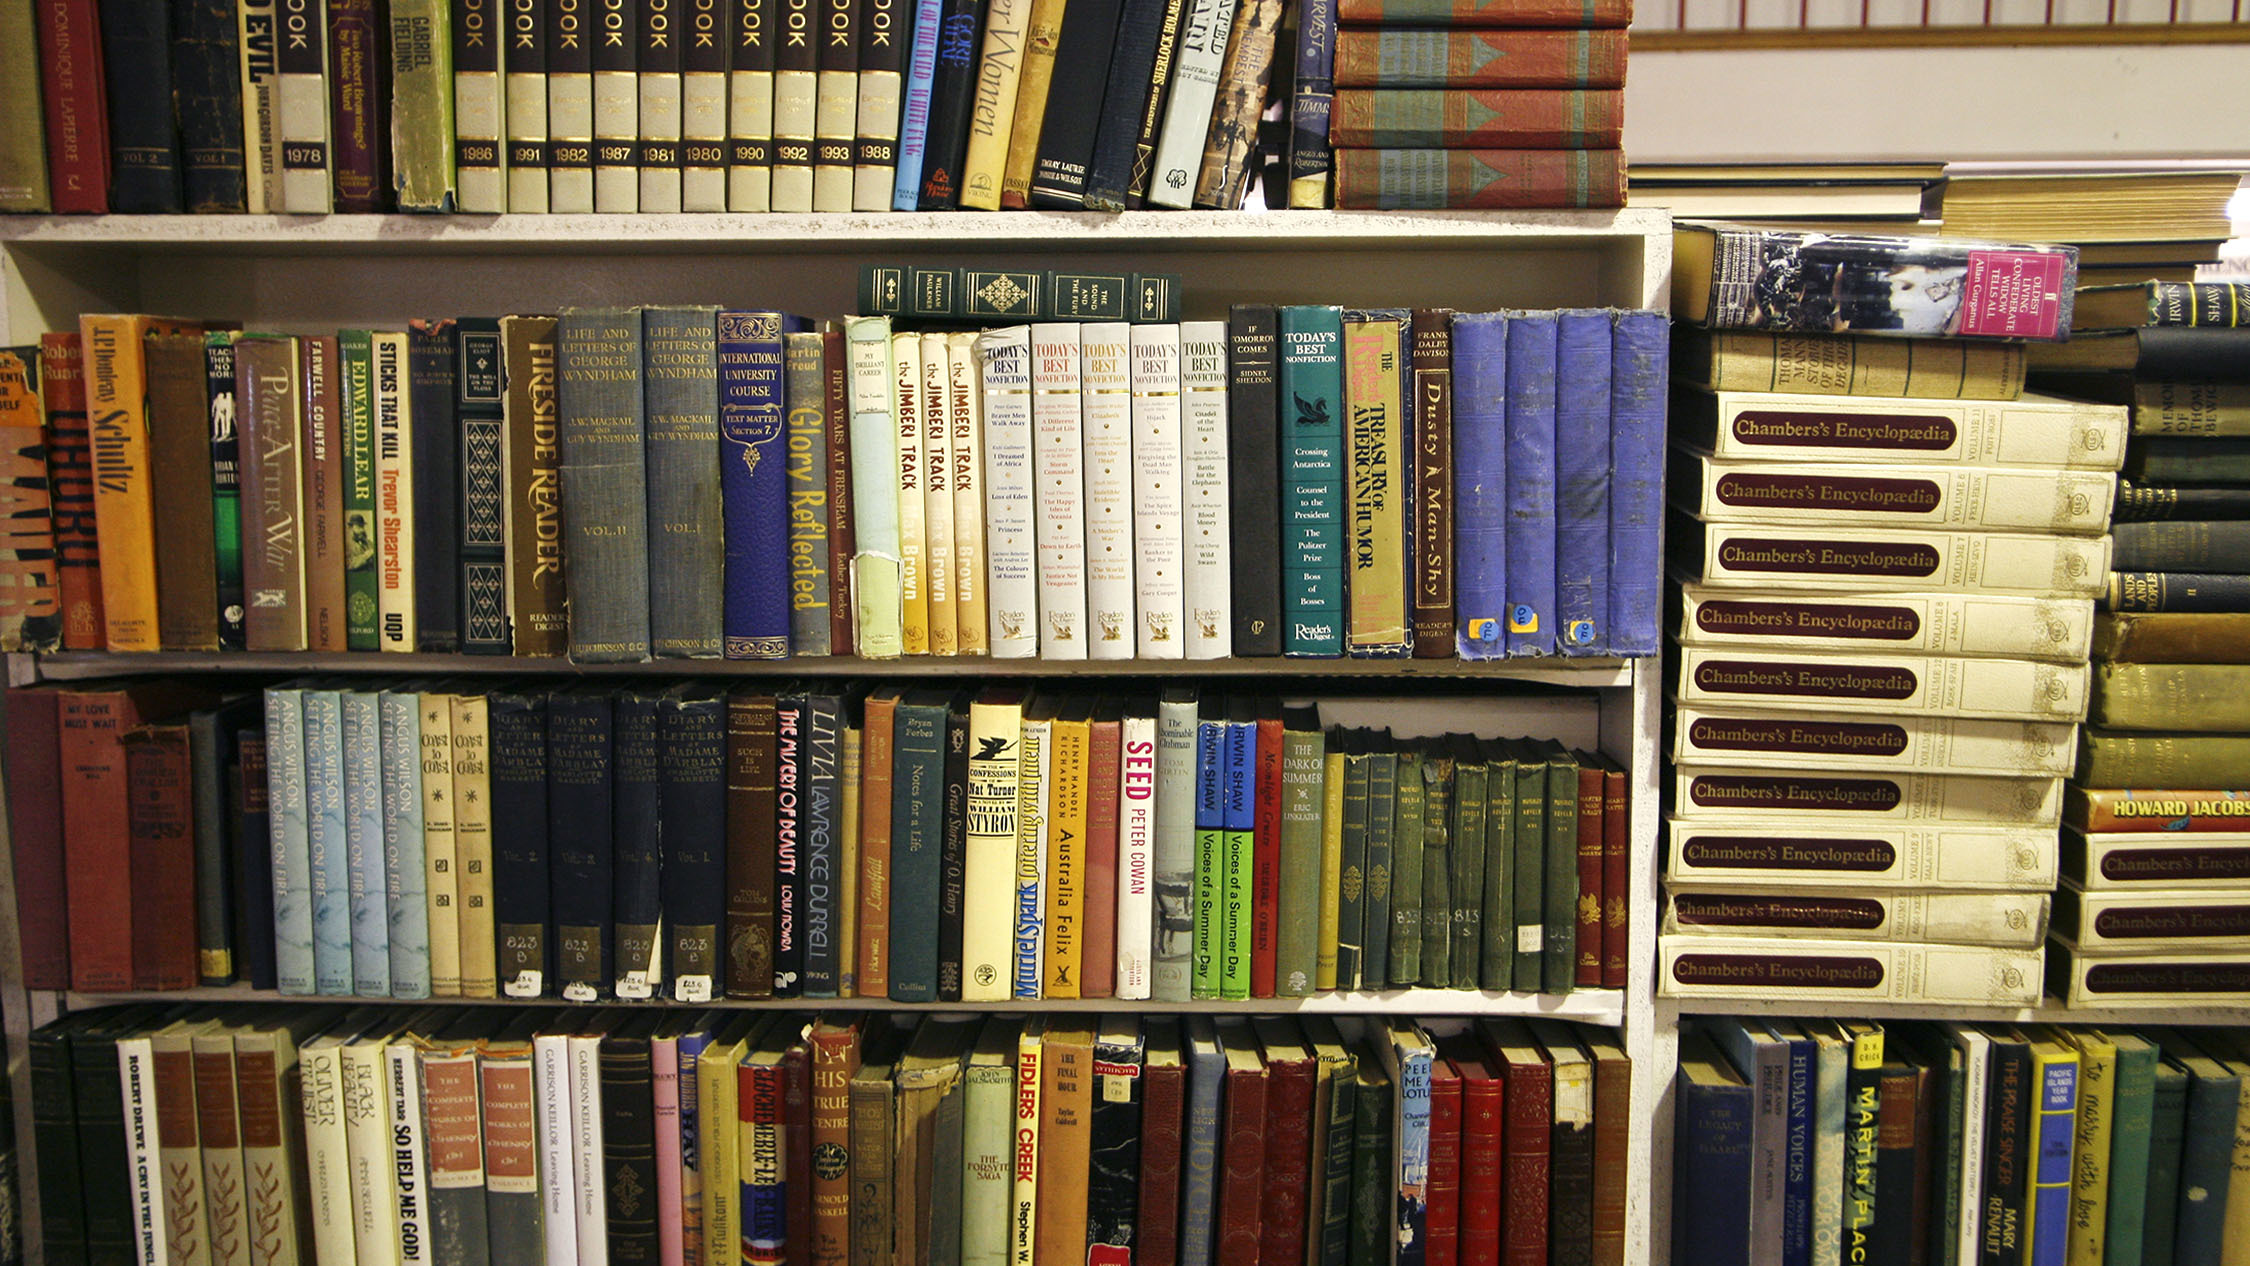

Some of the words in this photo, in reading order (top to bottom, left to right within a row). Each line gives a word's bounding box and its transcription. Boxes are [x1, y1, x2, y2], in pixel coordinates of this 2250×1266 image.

[54, 2, 73, 89] DOMINIQUE
[246, 14, 275, 83] EVIL
[394, 17, 413, 72] FIELDING
[412, 17, 430, 68] GABRIEL
[1153, 31, 1173, 86] SHERLOCK
[1235, 29, 1254, 85] TEMPEST
[1248, 47, 1264, 71] THE
[974, 29, 1019, 137] Women
[908, 89, 928, 126] WHITE
[60, 98, 79, 162] LAPIERRE
[905, 128, 925, 157] FANG
[288, 149, 321, 163] 1978
[462, 147, 493, 161] 1986
[515, 148, 541, 162] 1991
[555, 148, 588, 162] 1982
[600, 147, 631, 161] 1987
[643, 148, 675, 162] 1981
[686, 147, 721, 161] 1980
[735, 147, 764, 161] 1990
[778, 146, 808, 161] 1992
[819, 146, 849, 160] 1993
[860, 145, 890, 160] 1988
[1975, 259, 1985, 281] Allan
[1988, 269, 2000, 298] TELLS
[1967, 284, 1982, 328] Gurganus
[1986, 302, 1996, 319] ALL
[1998, 276, 2010, 314] WIDOW
[2006, 258, 2023, 332] CONFEDERATE
[2021, 278, 2031, 312] LIVING
[2031, 276, 2042, 316] OLDEST
[2168, 284, 2182, 322] IRWIN
[2208, 285, 2223, 322] SHAW
[986, 344, 1028, 359] TODAY'S
[1035, 343, 1078, 358] TODAY'S
[1286, 333, 1336, 343] TODAY'S
[1296, 344, 1326, 354] BEST
[311, 341, 323, 397] FARWELL
[380, 342, 398, 391] STICKS
[563, 371, 637, 380] WYNDHAM
[570, 356, 627, 366] GEORGE
[720, 352, 781, 364] INTERNATIONAL
[725, 369, 776, 380] UNIVERSITY
[994, 360, 1020, 374] BEST
[1044, 359, 1070, 372] BEST
[730, 386, 770, 396] COURSE
[832, 369, 844, 401] FIFTY
[986, 376, 1028, 384] NONFICTION
[1035, 375, 1078, 383] NONFICTION
[1236, 376, 1272, 384] SHELDON
[352, 360, 369, 442] EDWARD
[380, 396, 399, 430] THAT
[528, 343, 556, 460] FIRESIDE
[750, 415, 778, 423] MATTER
[899, 379, 915, 437] JIMBERI
[927, 381, 943, 439] JIMBERI
[1425, 383, 1441, 456] Dusty
[313, 406, 326, 462] COUNTRY
[788, 407, 823, 481] Glory
[833, 408, 845, 444] YEARS
[1737, 420, 1830, 437] Chambers's
[1836, 423, 1950, 441] Encyclopædia
[93, 410, 134, 495] Schultz
[382, 432, 399, 460] KILL
[1293, 460, 1331, 469] Antarctica
[1295, 448, 1328, 458] Crossing
[1354, 405, 1371, 498] AMERICAN
[1370, 403, 1387, 493] TREASURY
[355, 446, 370, 500] LEAR
[901, 445, 916, 490] TRACK
[930, 447, 945, 492] TRACK
[50, 410, 100, 568] UHURU
[383, 469, 400, 514] Trevor
[835, 469, 846, 529] FRENSHAM
[1297, 486, 1327, 494] Counsel
[528, 468, 559, 590] READER
[1295, 511, 1329, 519] President
[1304, 529, 1320, 537] The
[384, 517, 402, 589] Shearston
[790, 489, 828, 611] Reflected
[1299, 541, 1326, 549] Pulitzer
[1356, 502, 1373, 570] HUMOR
[1425, 487, 1441, 596] Man-Shy
[903, 545, 918, 600] Brown
[932, 547, 947, 601] Brown
[1303, 554, 1322, 562] Prize
[1723, 547, 1815, 564] Chambers's
[1821, 550, 1934, 568] Encyclopædia
[1301, 597, 1325, 605] Bosses
[2125, 574, 2136, 608] LANDS
[385, 613, 402, 642] UQP
[1700, 609, 1792, 625] Chambers's
[1799, 612, 1912, 631] Encyclopædia
[267, 699, 280, 756] SETTING
[282, 700, 298, 751] ANGUS
[811, 709, 836, 782] LIVIA
[1071, 736, 1079, 771] HENRY
[1233, 726, 1245, 766] IRWIN
[1284, 759, 1310, 769] DARK
[285, 753, 299, 808] WILSON
[911, 764, 923, 796] Notes
[969, 782, 983, 796] Nat
[970, 769, 1016, 777] CONFESSIONS
[1126, 741, 1153, 800] SEED
[1283, 772, 1322, 783] SUMMER
[970, 805, 1015, 813] WILLIAM
[1070, 775, 1079, 819] HANDEL
[1232, 771, 1244, 811] SHAW
[2114, 800, 2187, 816] HOWARD
[271, 790, 284, 839] WORLD
[810, 786, 830, 880] LAWRENCE
[967, 813, 1015, 834] STYRON
[1131, 809, 1145, 847] PETER
[910, 830, 922, 851] Life
[1230, 835, 1242, 875] Voices
[276, 869, 288, 897] FIRE
[1058, 828, 1074, 907] Australia
[1130, 852, 1145, 895] COWAN
[809, 884, 828, 960] DURRELL
[1016, 882, 1043, 936] Spark
[1228, 902, 1240, 953] Summer
[1056, 915, 1072, 955] Felix
[1014, 938, 1038, 998] Muriel
[1226, 957, 1238, 980] Day
[1676, 962, 1764, 978] Chambers's
[1770, 964, 1878, 982] Encyclopædia
[129, 1055, 142, 1105] ROBERT
[545, 1048, 557, 1101] GARRISON
[814, 1071, 846, 1087] HIS
[1020, 1053, 1036, 1119] FIDLERS
[1792, 1055, 1807, 1118] HUMAN
[2050, 1069, 2071, 1077] PACIFIC
[814, 1096, 849, 1110] TRUE
[133, 1107, 145, 1150] DREWE
[394, 1124, 411, 1146] SO
[548, 1103, 558, 1146] KEILLOR
[1855, 1086, 1875, 1185] MARTIN
[396, 1149, 414, 1191] HELP
[549, 1150, 560, 1186] Leaving
[1017, 1128, 1034, 1183] CREEK
[1790, 1123, 1805, 1182] VOICES
[977, 1172, 1001, 1180] SAGA
[399, 1195, 416, 1219] ME
[551, 1187, 560, 1214] Home
[401, 1222, 419, 1260] GOD!
[1018, 1201, 1031, 1247] Stephen
[1986, 1197, 2002, 1255] RENAULT
[2003, 1208, 2017, 1249] MARY
